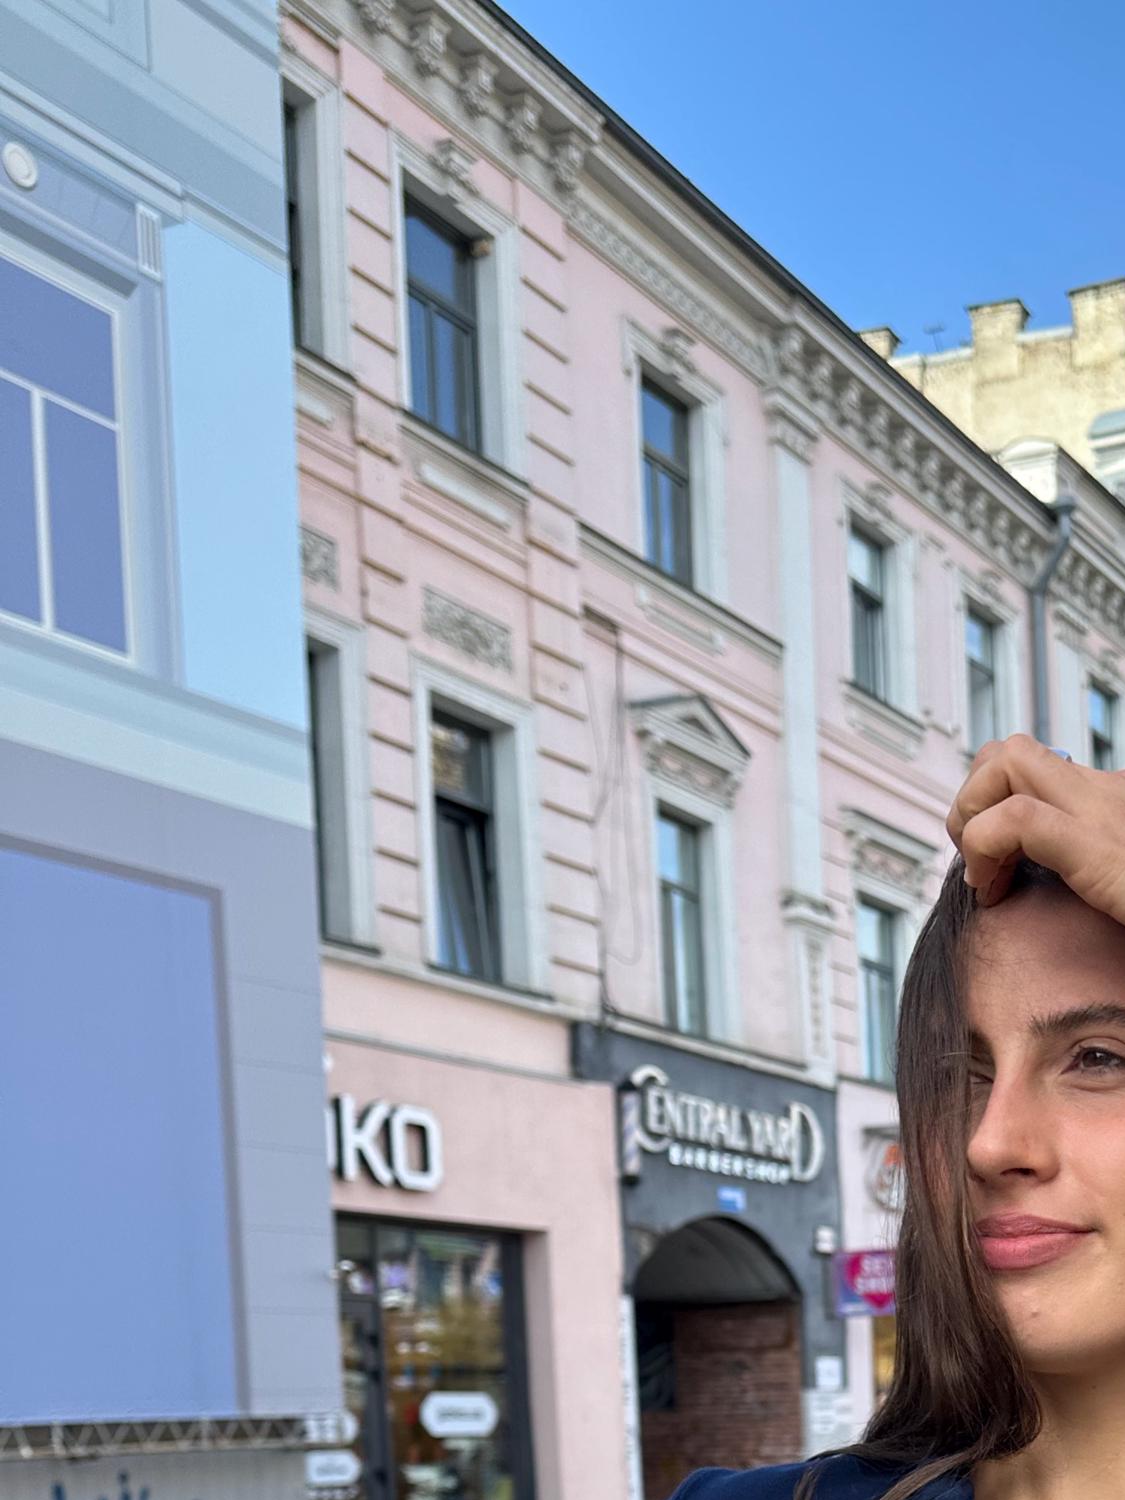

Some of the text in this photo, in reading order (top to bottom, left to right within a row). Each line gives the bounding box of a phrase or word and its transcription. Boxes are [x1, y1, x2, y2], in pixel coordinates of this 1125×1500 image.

[324, 1092, 443, 1192] KO
[630, 1064, 748, 1153] CENTRAL
[747, 1101, 825, 1182] YARD
[668, 1142, 792, 1186] BARBERSHOP
